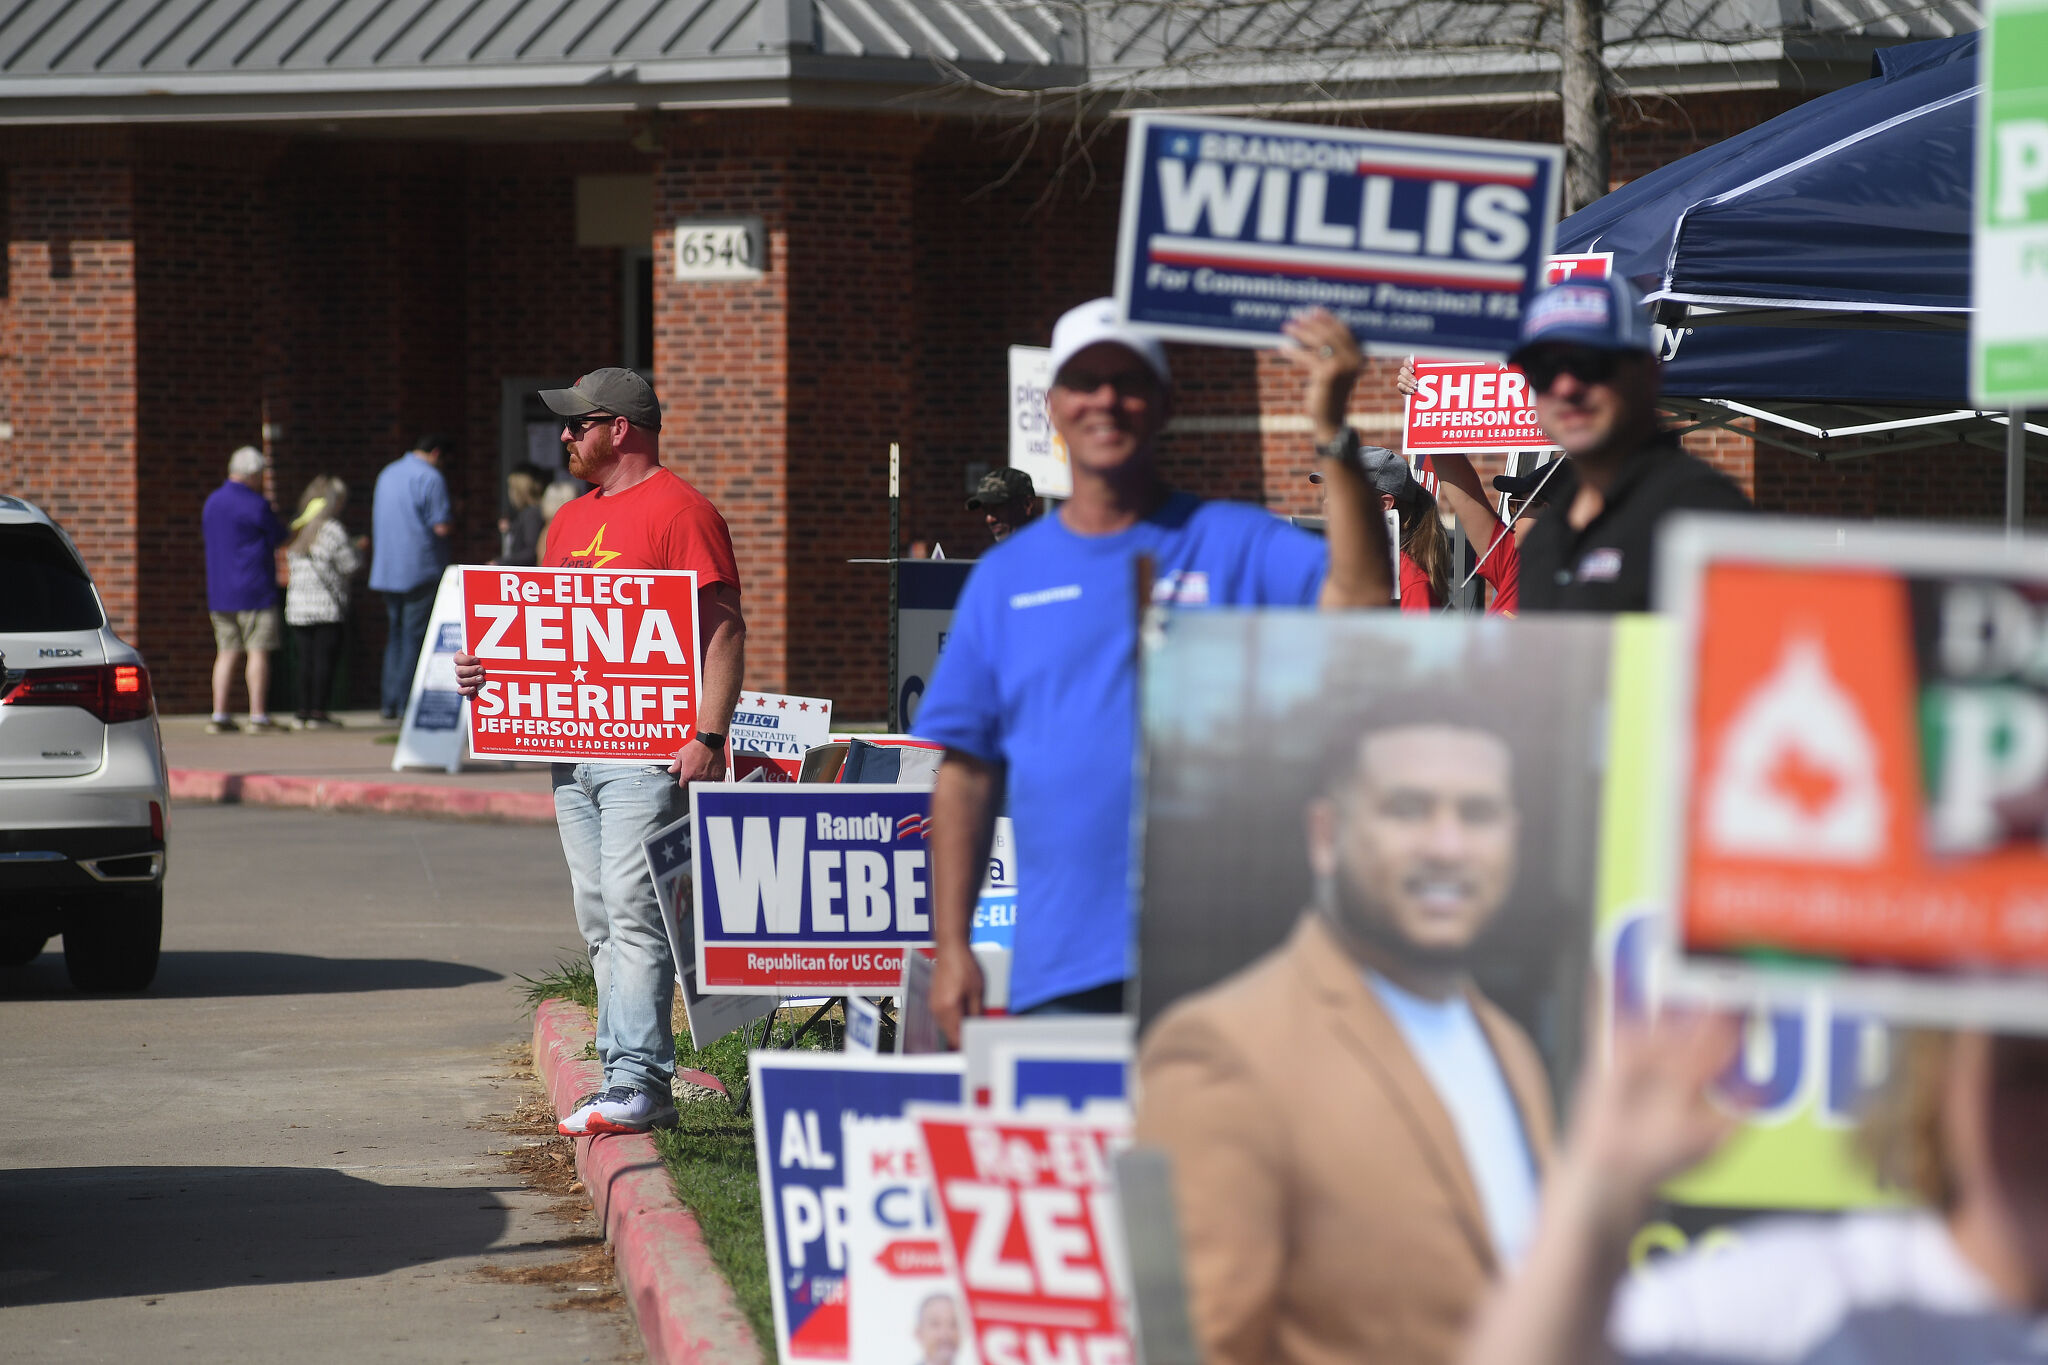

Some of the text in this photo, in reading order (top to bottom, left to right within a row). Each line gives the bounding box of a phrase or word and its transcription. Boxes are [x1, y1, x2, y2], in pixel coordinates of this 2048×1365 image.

[1201, 132, 1361, 174] BRANDON
[1156, 156, 1531, 262] WILLIS
[682, 231, 753, 268] 6540
[1146, 262, 1189, 292] For
[1196, 267, 1373, 305] Commissioner
[1375, 282, 1483, 315] Precinct
[1412, 410, 1511, 428] JEFFERSON
[1442, 427, 1547, 439] PROVEN LEADERSH
[500, 573, 655, 606] Re-ELECT
[474, 604, 687, 665] ZENA
[477, 681, 689, 721] SHERIFF
[478, 717, 691, 739] JEFFERSON COUNTY
[515, 737, 650, 750] PROVEN LEADERSHIP
[816, 812, 893, 843] Randy
[705, 816, 930, 934] WEBE
[747, 953, 826, 973] Republican
[829, 953, 849, 970] for
[852, 954, 871, 970] US
[779, 1108, 836, 1170] AL
